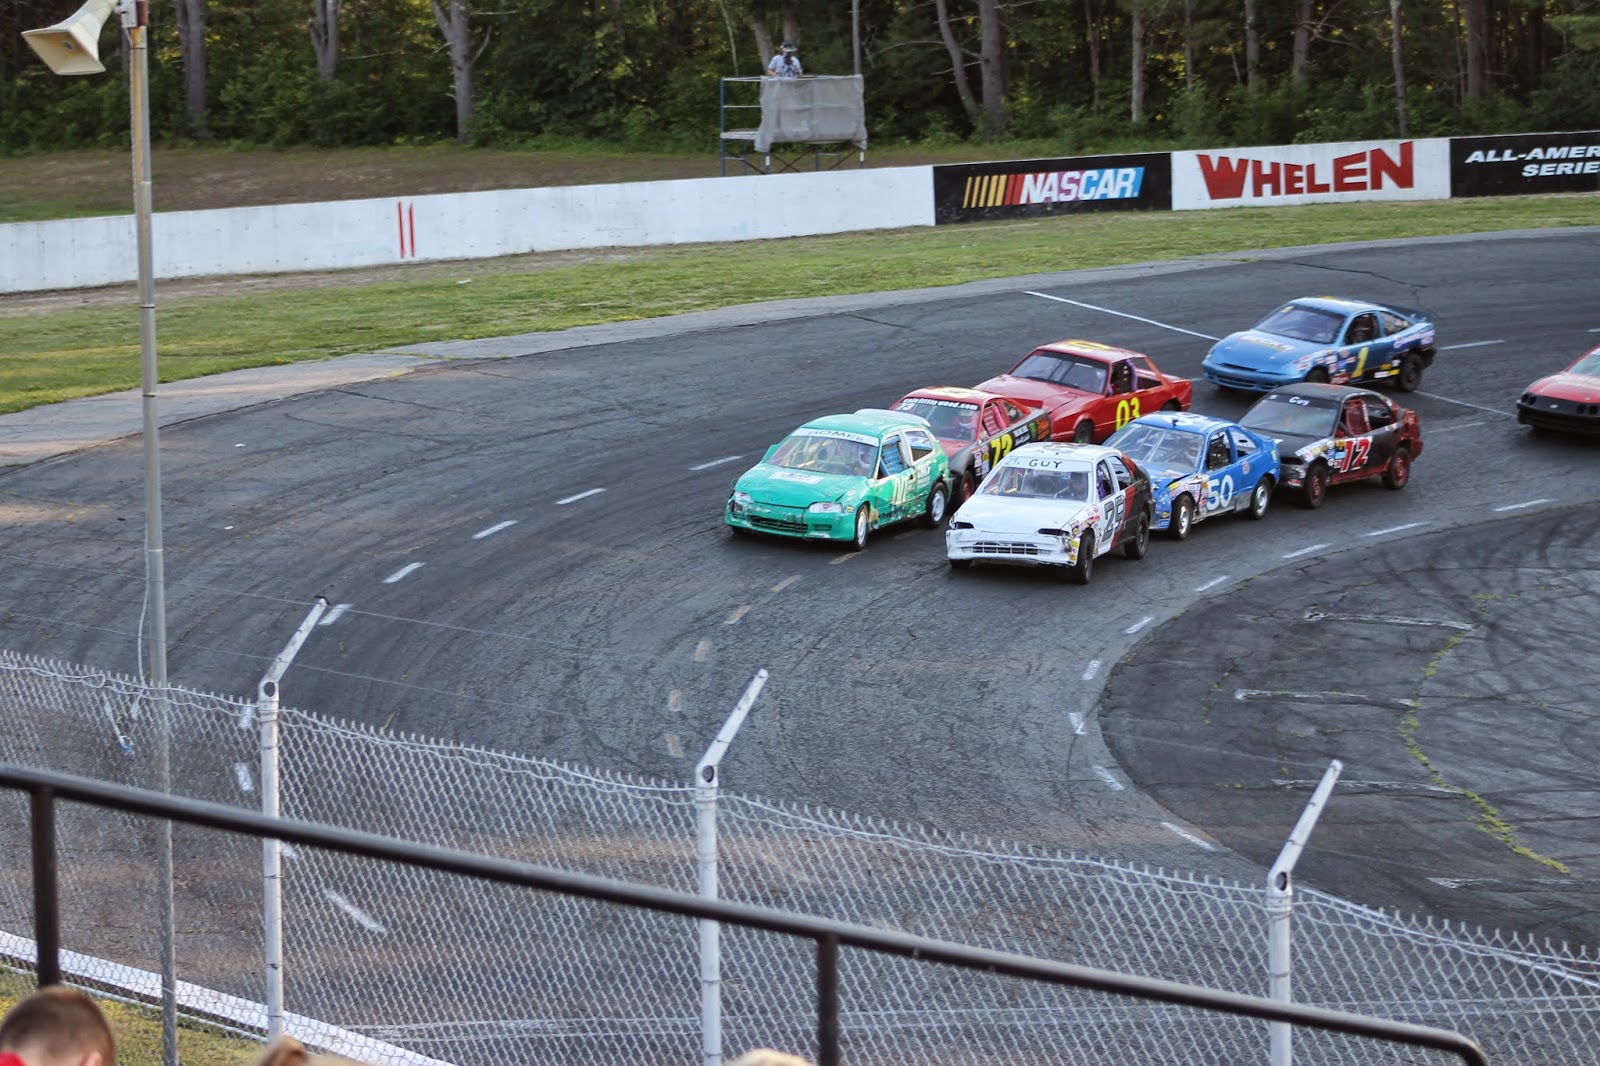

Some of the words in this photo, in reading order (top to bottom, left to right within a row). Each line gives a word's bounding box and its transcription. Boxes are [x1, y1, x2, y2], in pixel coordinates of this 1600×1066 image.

[1020, 167, 1139, 204] NASCAR
[1197, 140, 1414, 201] WHELEN
[1521, 161, 1600, 177] SERIE
[1350, 346, 1370, 378] 1
[1115, 396, 1141, 432] 03
[1029, 458, 1063, 469] GUY
[1339, 436, 1373, 474] 12
[1205, 474, 1234, 511] 50
[1101, 494, 1125, 543] 29
